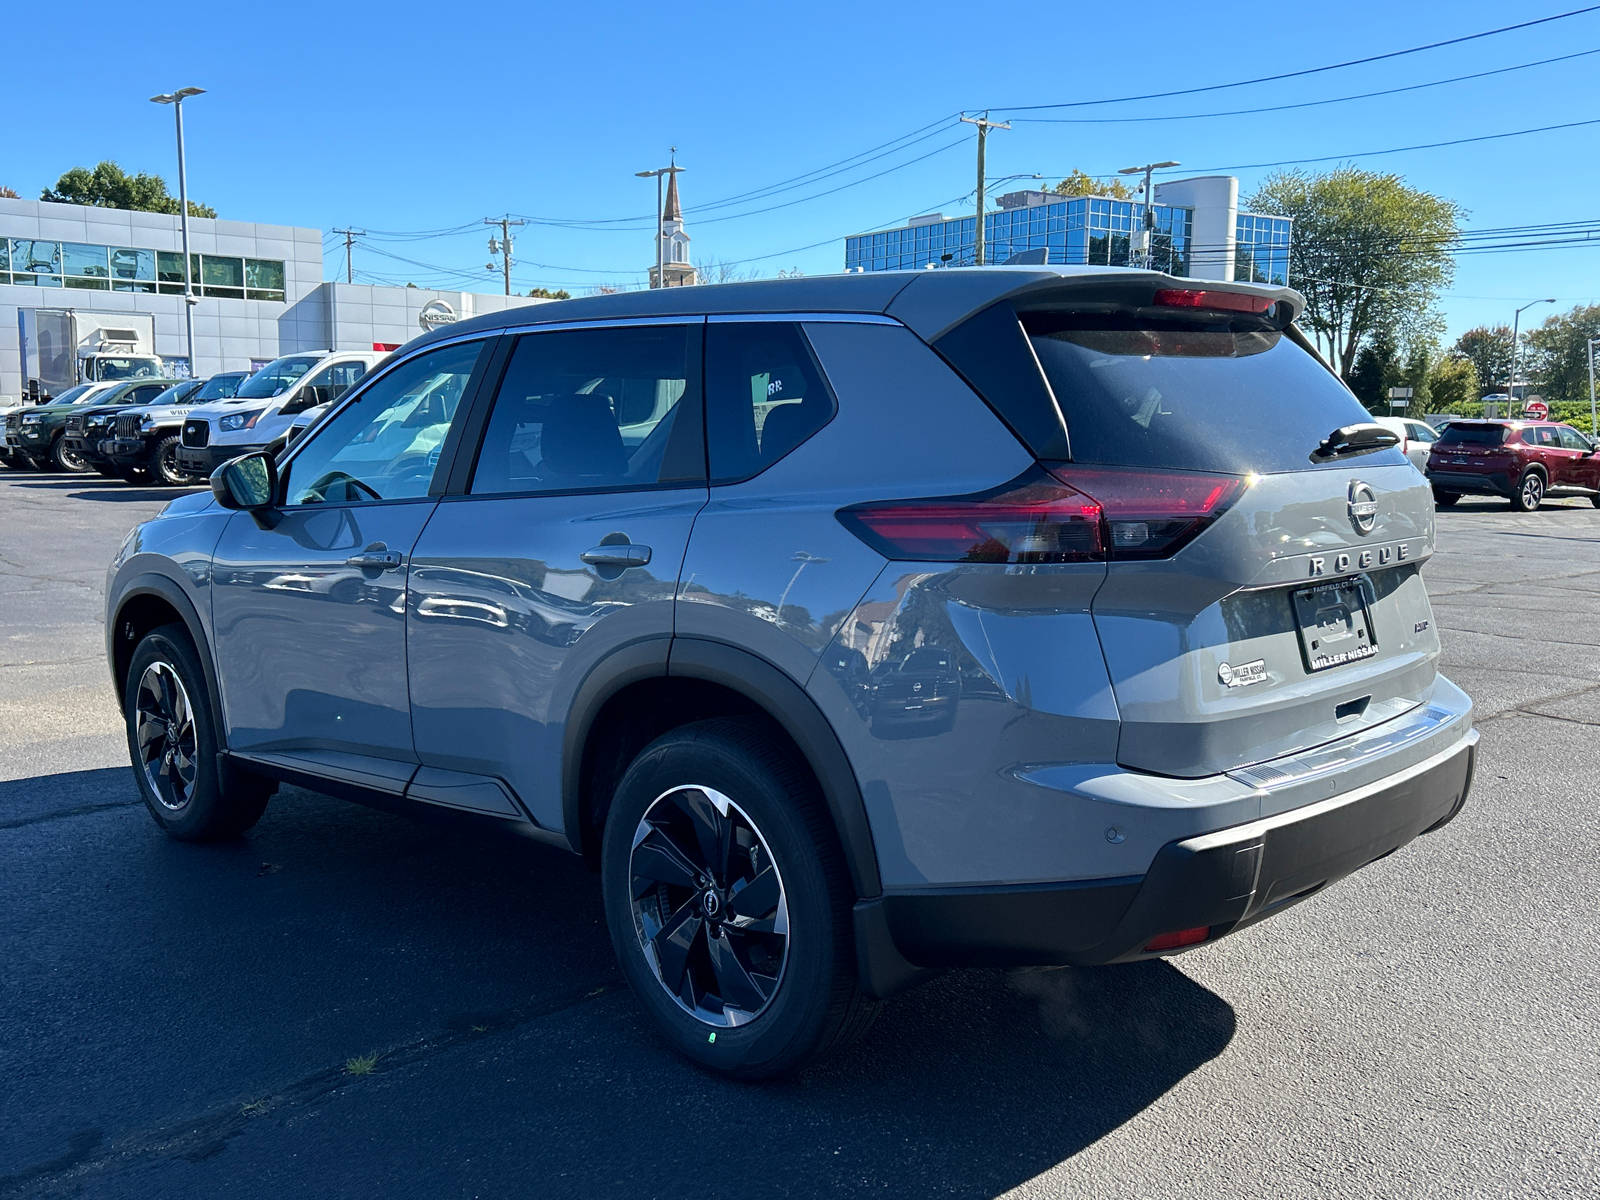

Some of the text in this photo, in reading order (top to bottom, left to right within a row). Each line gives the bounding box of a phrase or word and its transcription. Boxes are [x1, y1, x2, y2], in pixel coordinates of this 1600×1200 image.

[424, 314, 456, 322] NISSAN
[1309, 544, 1409, 577] ROGUE
[1311, 644, 1379, 670] MILLER NISSAN
[1232, 664, 1265, 679] MILLER NISSAN
